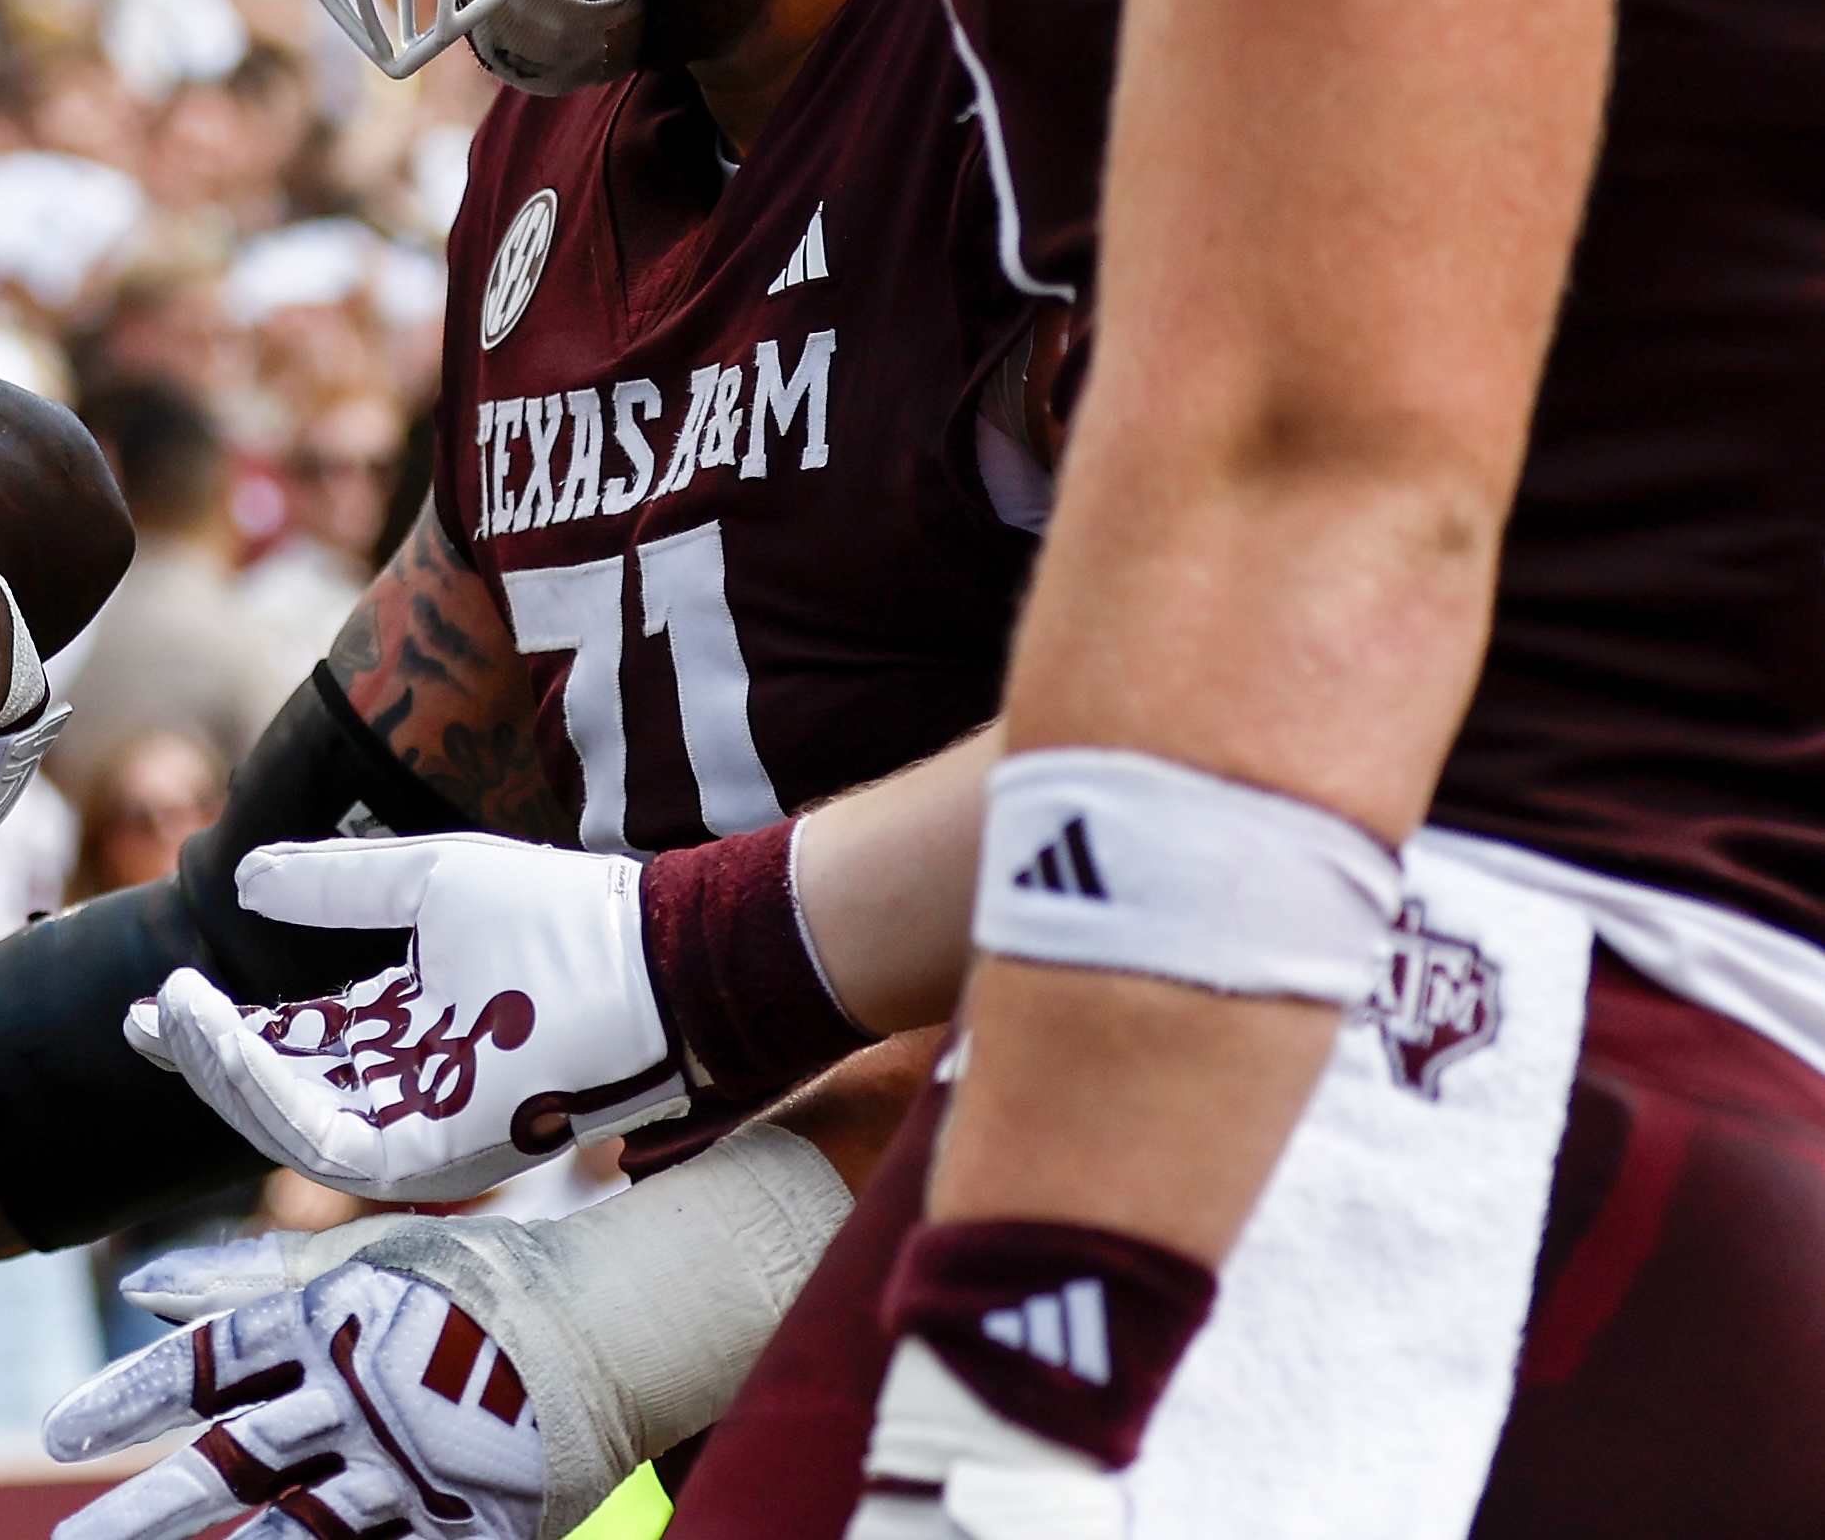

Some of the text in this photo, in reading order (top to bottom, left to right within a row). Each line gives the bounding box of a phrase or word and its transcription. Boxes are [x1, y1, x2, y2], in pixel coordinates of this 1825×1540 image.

[474, 328, 836, 540] TEXAS A&M
[501, 520, 782, 855] 71
